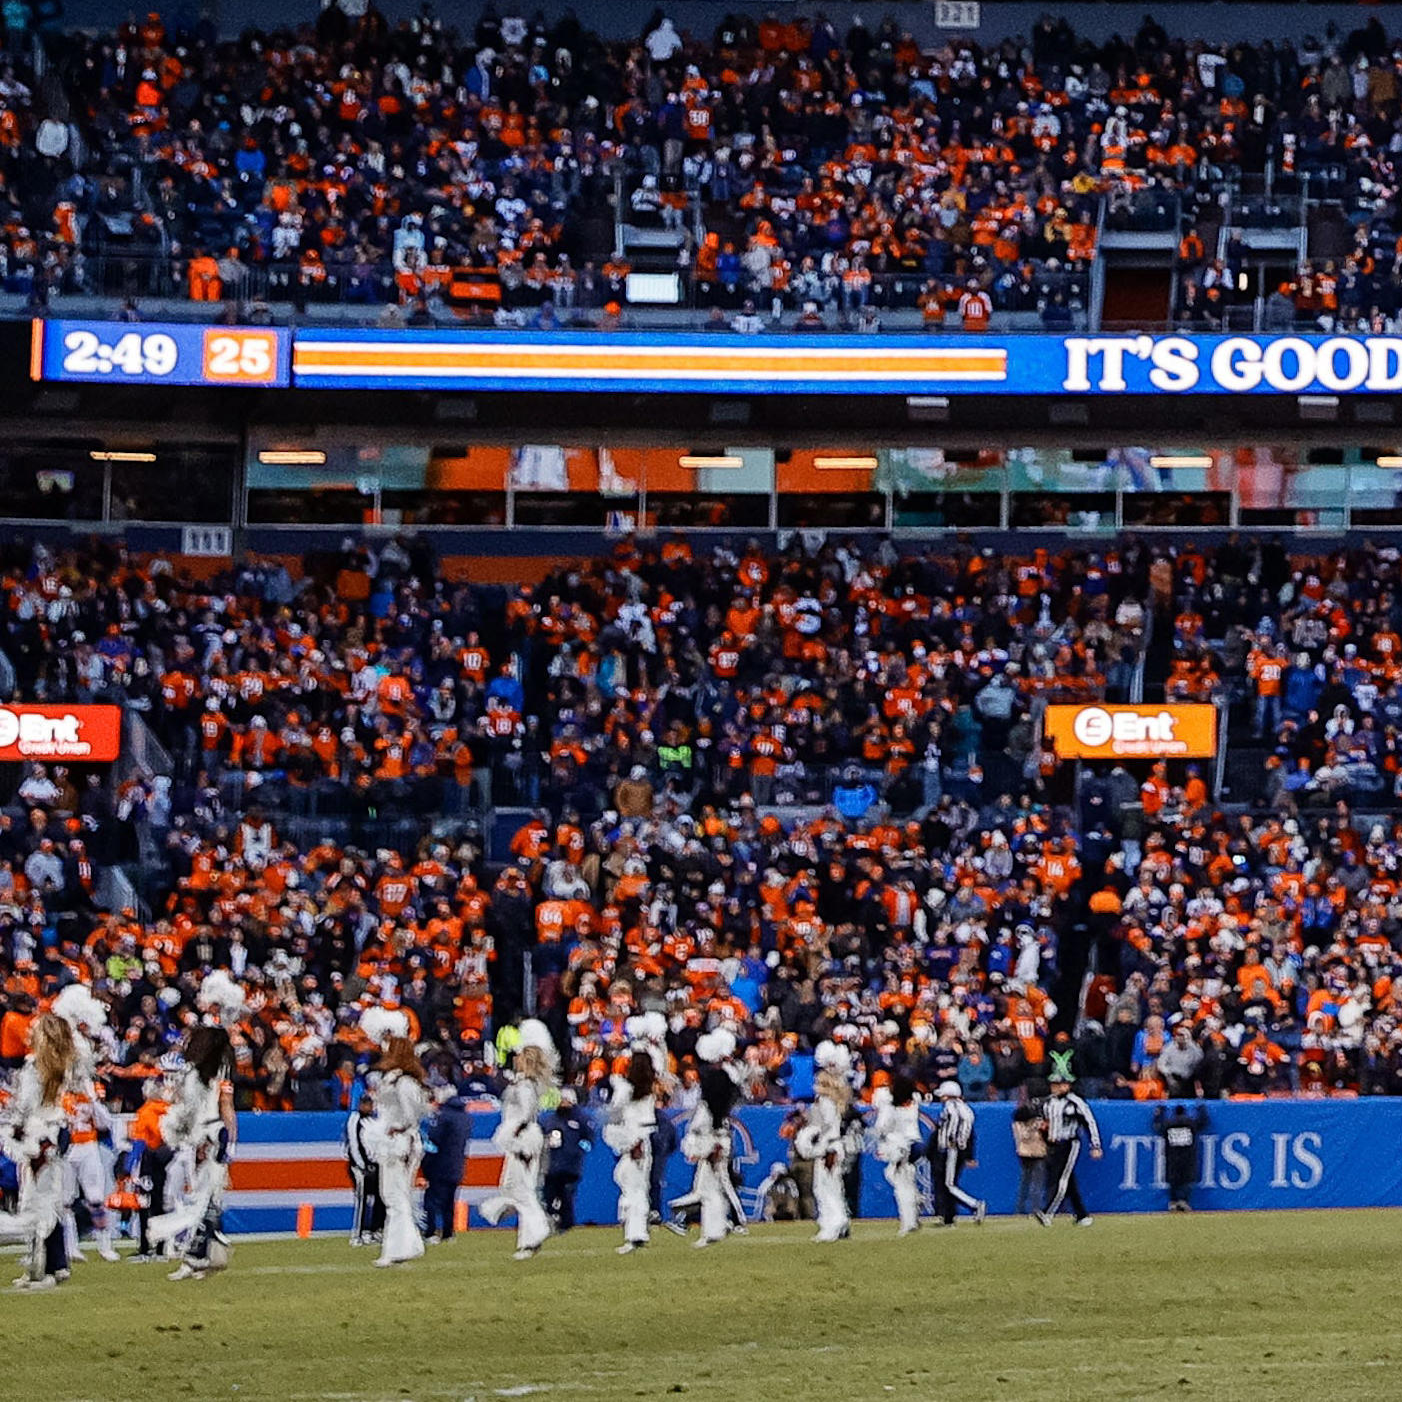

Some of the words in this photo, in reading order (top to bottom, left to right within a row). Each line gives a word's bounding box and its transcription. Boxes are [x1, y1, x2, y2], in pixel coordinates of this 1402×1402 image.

[62, 331, 178, 374] 2:49
[207, 337, 272, 373] 25
[1062, 336, 1200, 392] IT'S
[19, 713, 79, 742] Ent
[1113, 711, 1174, 741] Ent
[1270, 1131, 1323, 1189] IS
